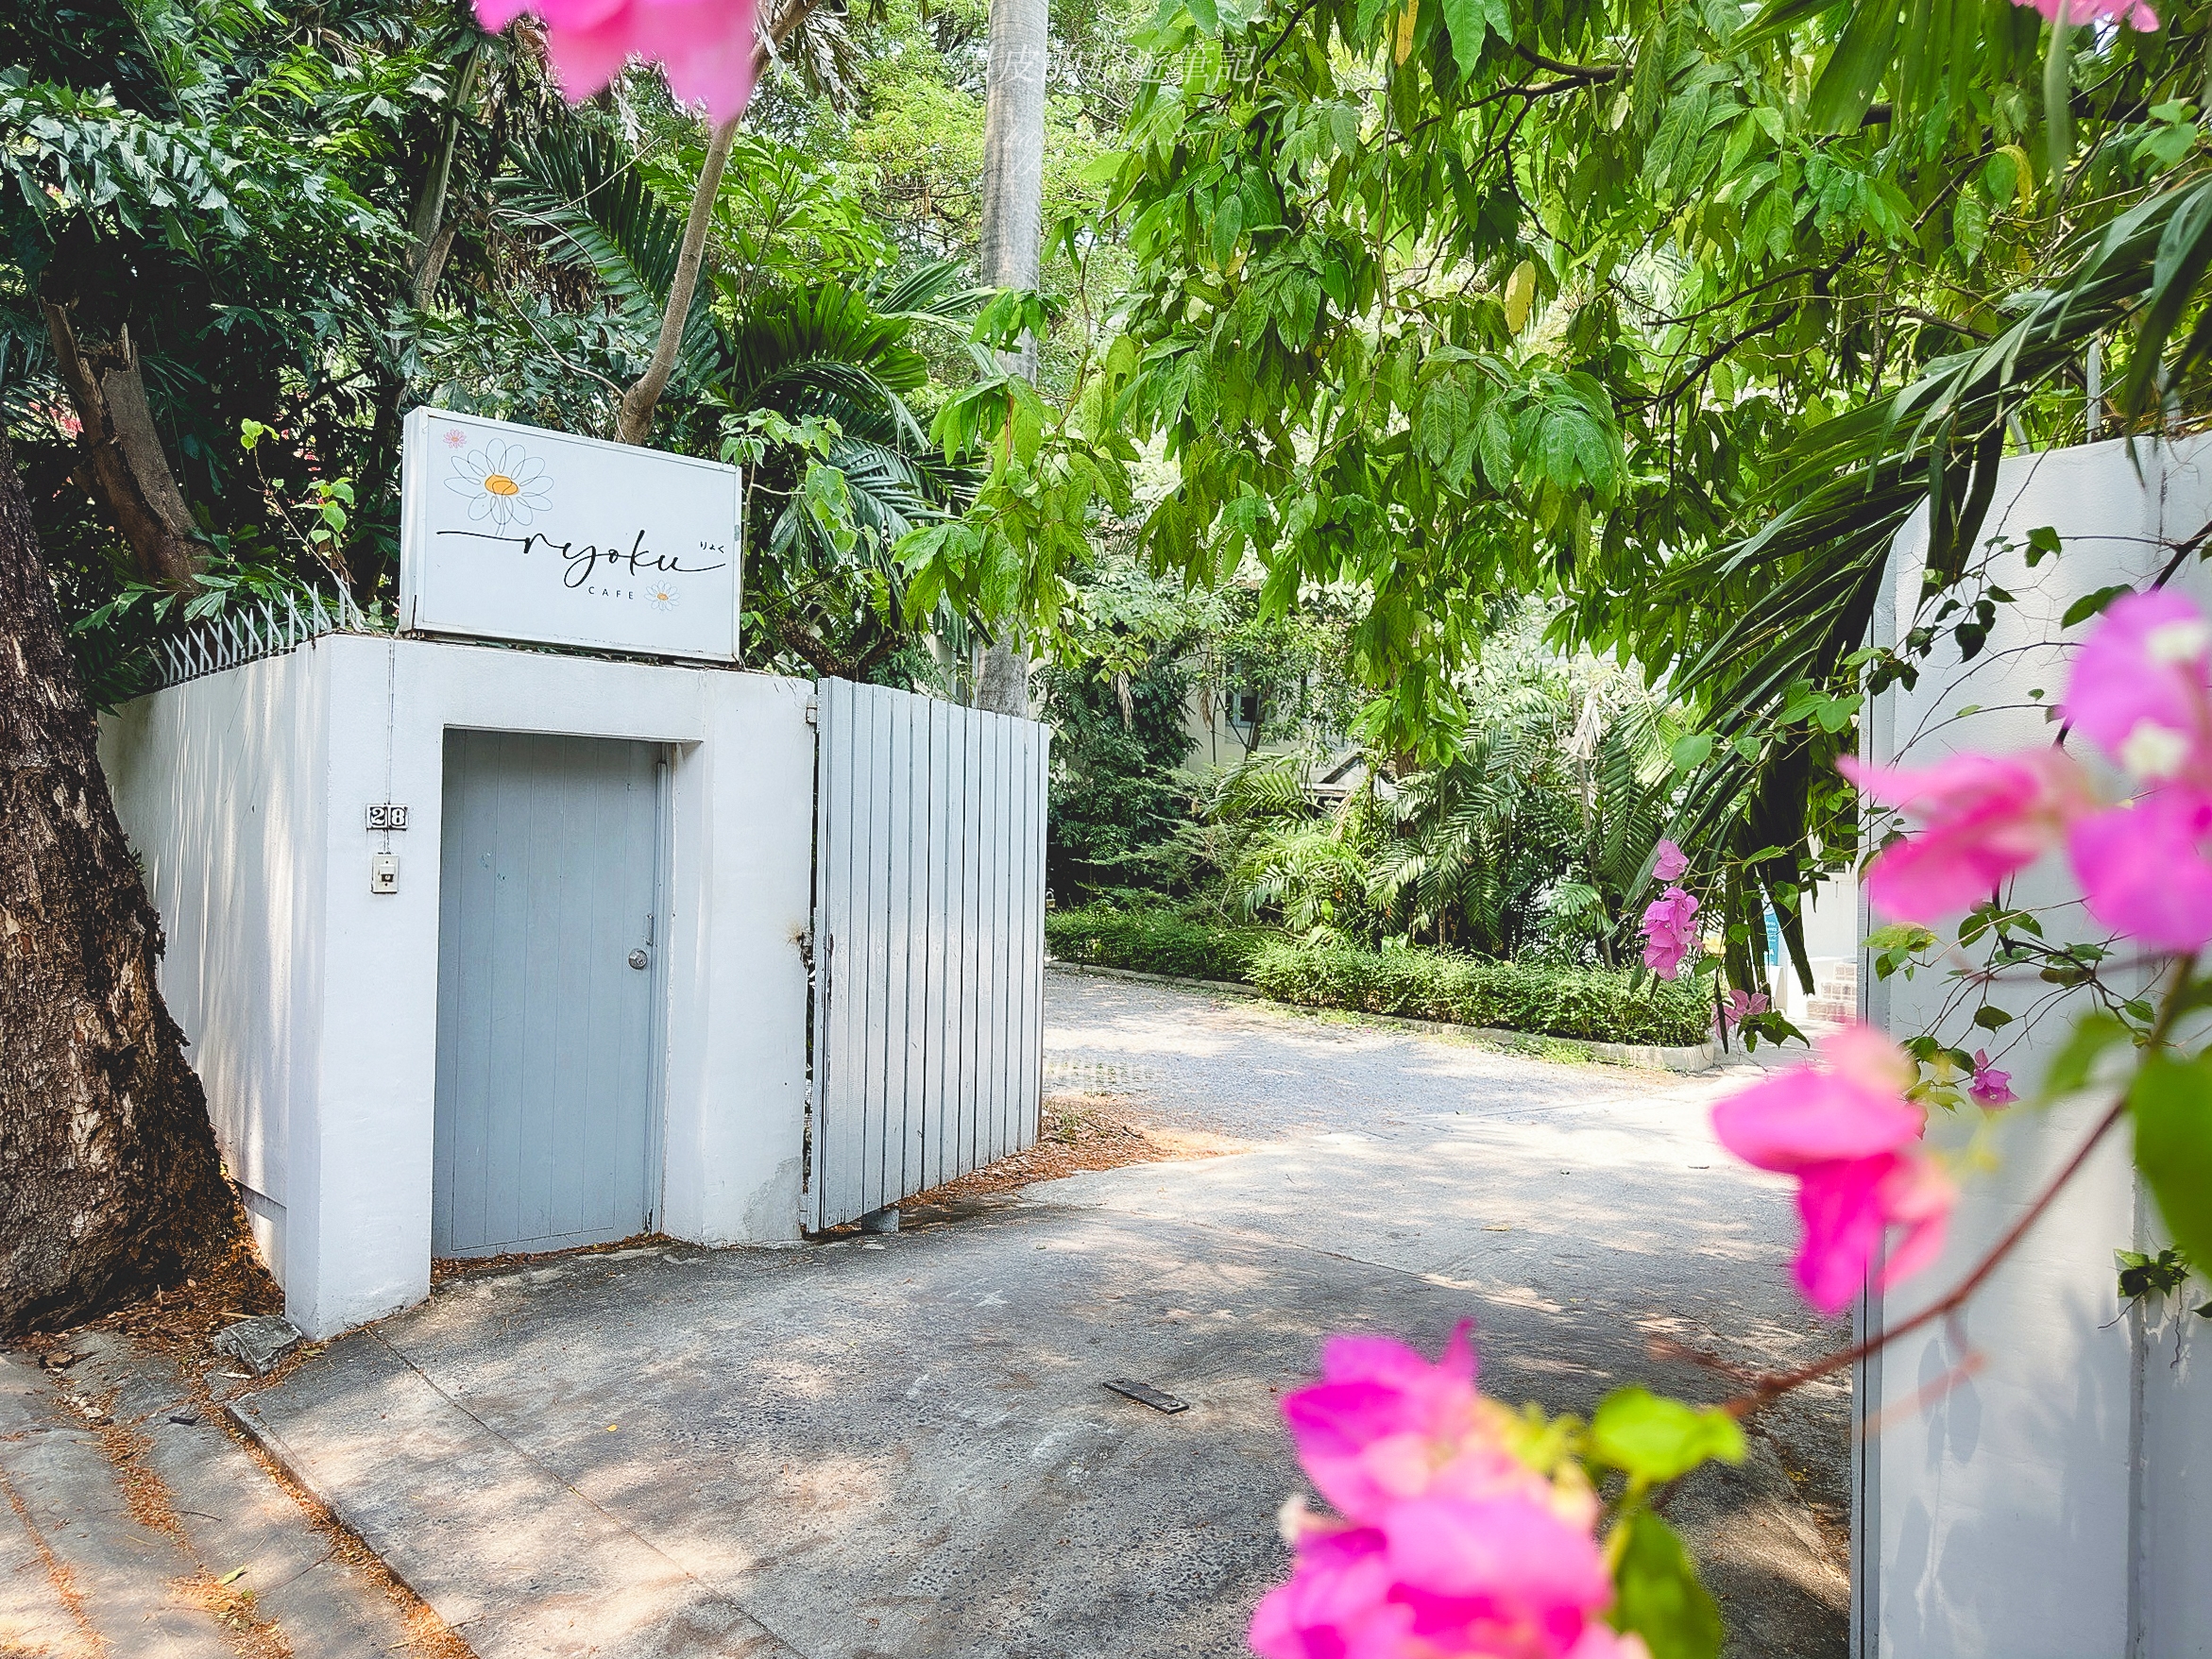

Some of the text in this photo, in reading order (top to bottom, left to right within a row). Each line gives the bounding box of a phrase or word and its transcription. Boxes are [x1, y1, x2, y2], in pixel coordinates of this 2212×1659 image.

[700, 541, 724, 554] りょく
[436, 530, 726, 588] ryoku
[588, 586, 635, 600] CAFE
[369, 805, 406, 827] 28
